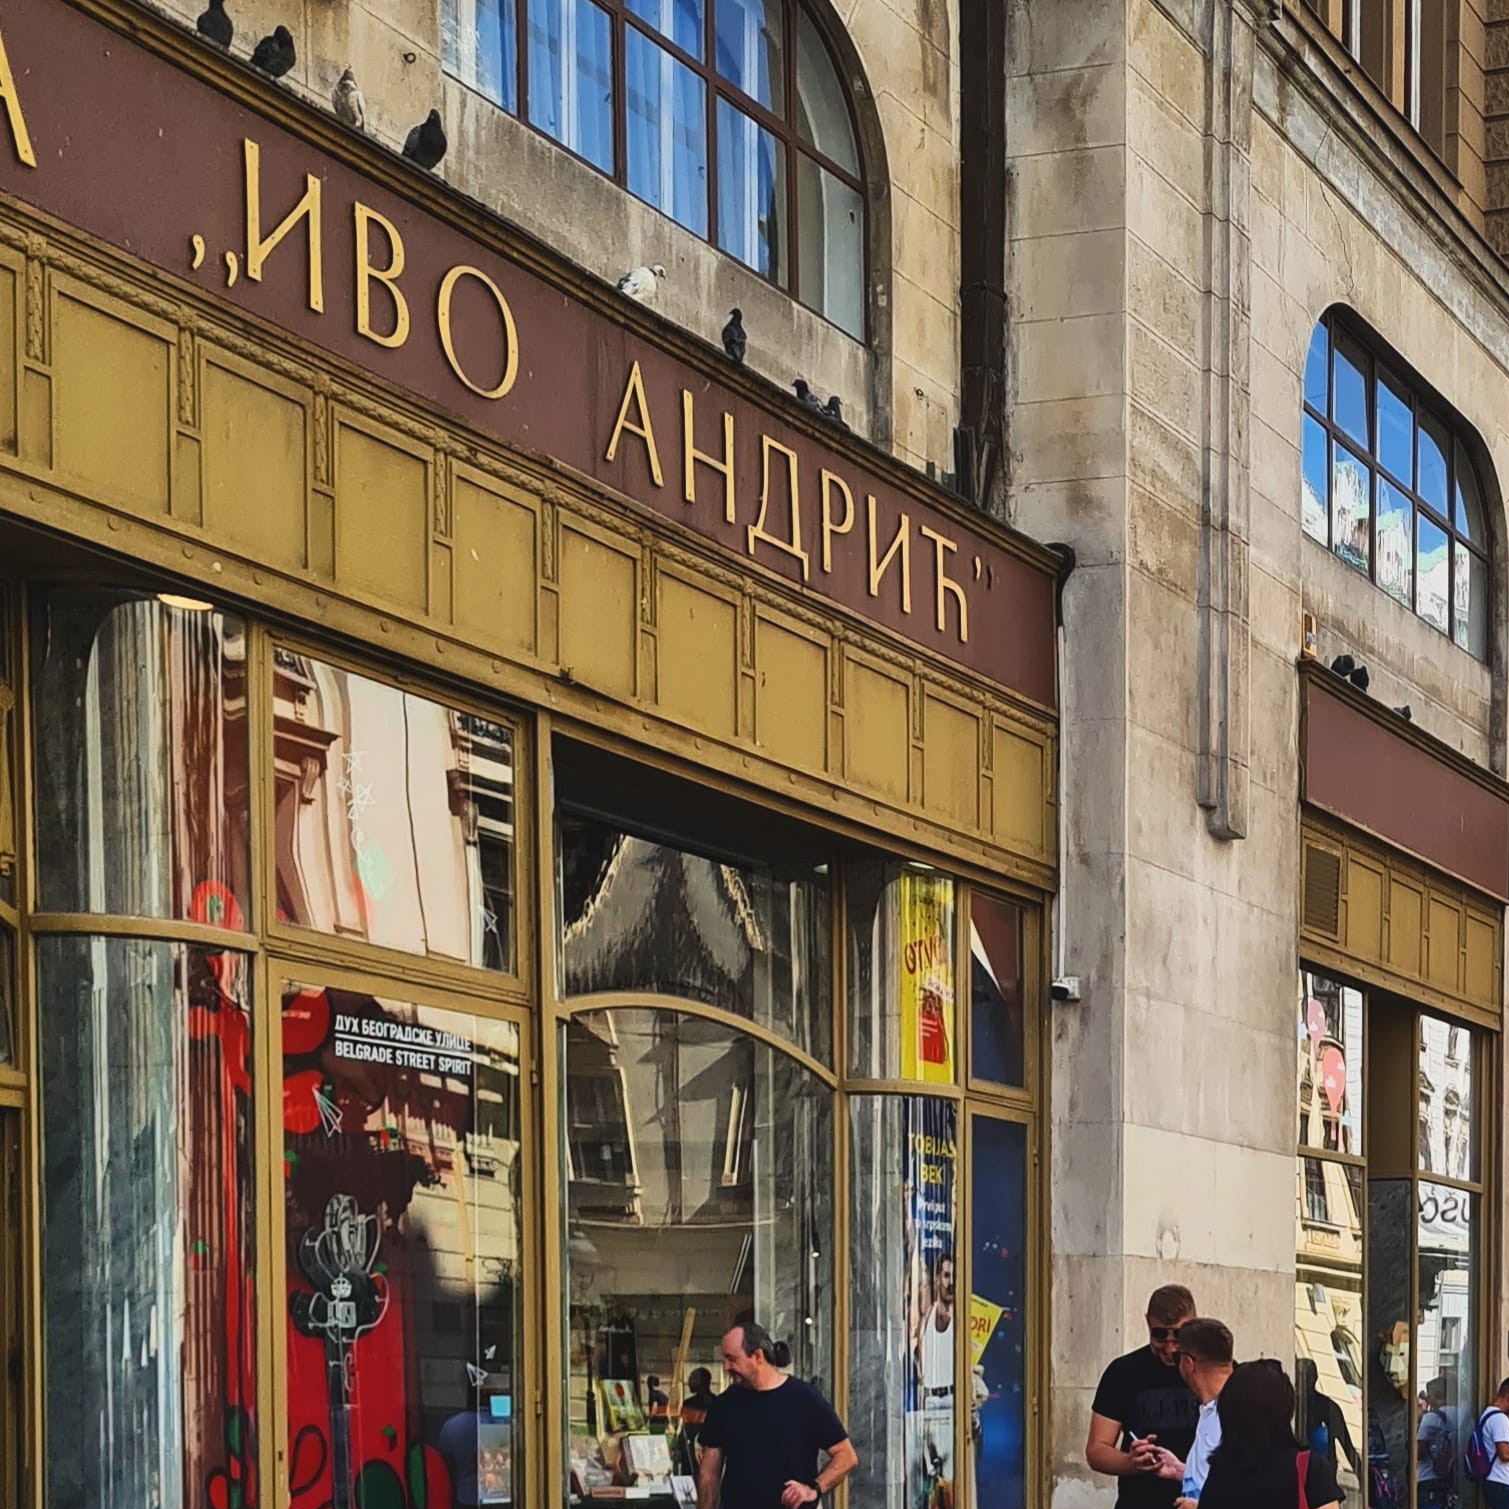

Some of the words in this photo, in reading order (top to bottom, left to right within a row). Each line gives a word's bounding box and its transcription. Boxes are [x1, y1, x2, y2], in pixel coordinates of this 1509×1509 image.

[334, 1014, 360, 1033] ДУХ
[361, 1019, 434, 1045] БЕОГРАДСКЕ
[435, 1029, 472, 1051] УЛИЦЕ
[335, 1040, 393, 1064] BELGRADE
[395, 1050, 436, 1070] STREET
[438, 1053, 473, 1075] SPIRIT
[920, 1161, 943, 1185] BEK
